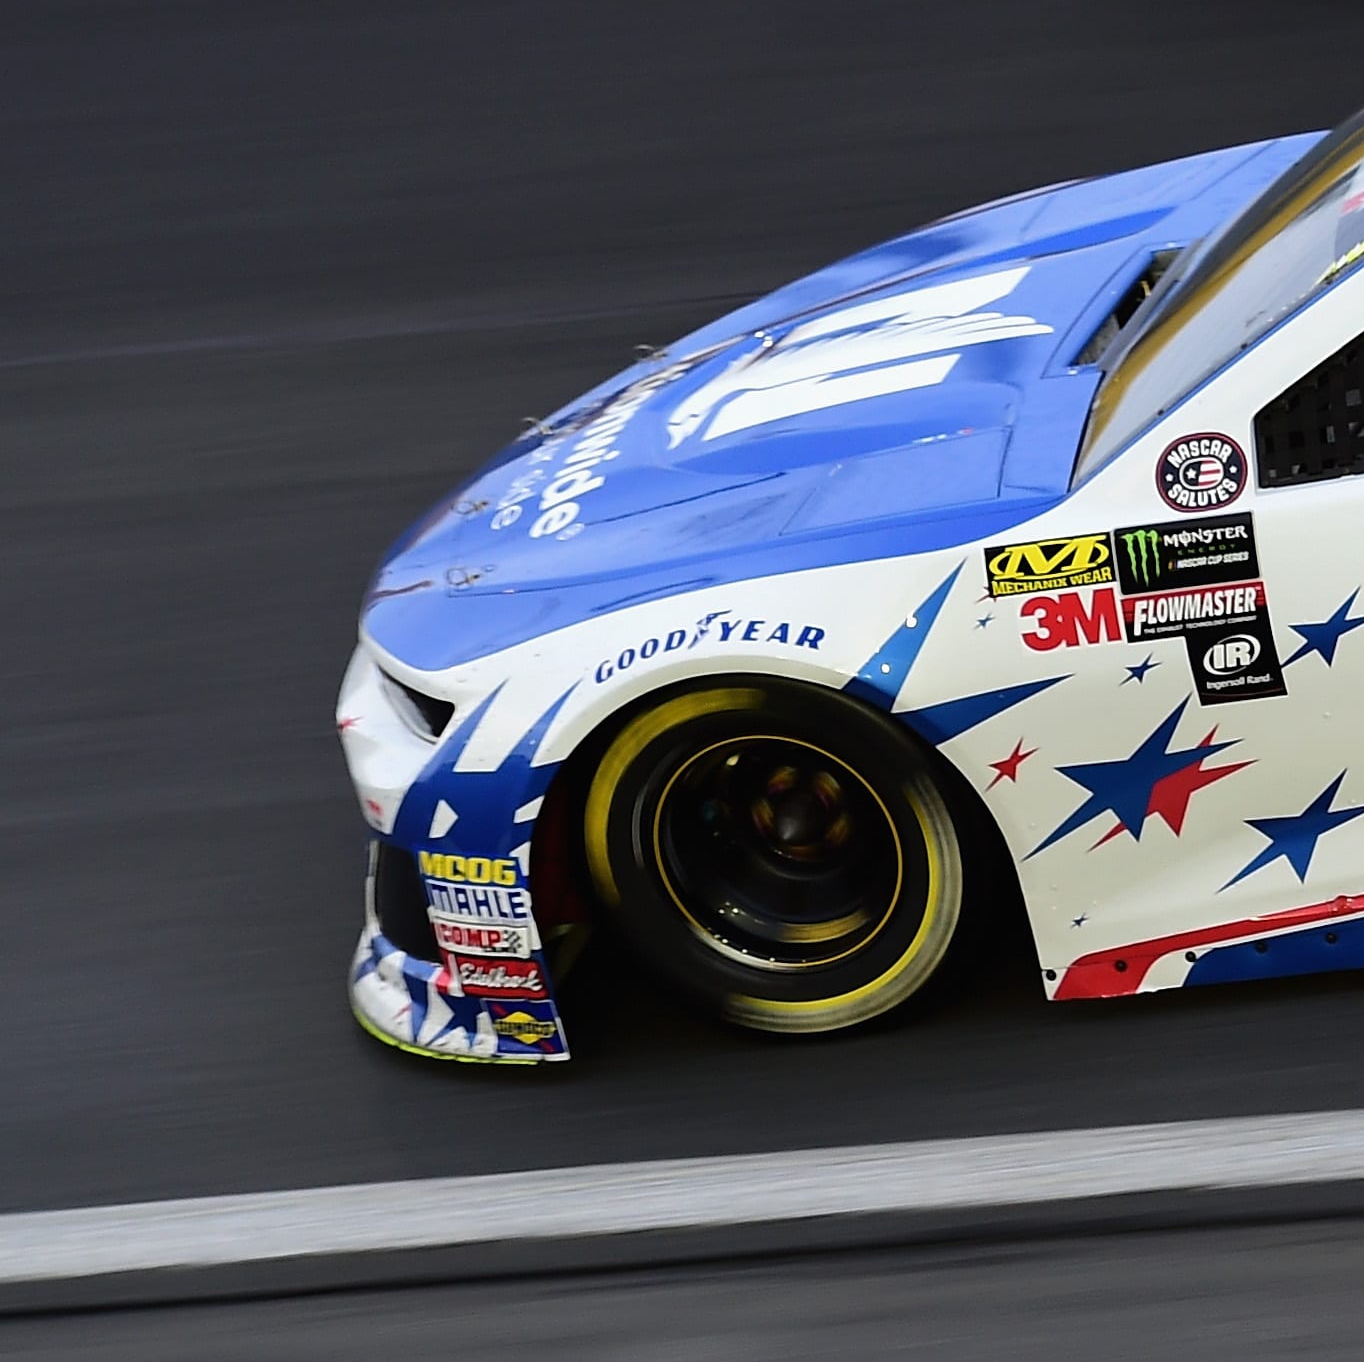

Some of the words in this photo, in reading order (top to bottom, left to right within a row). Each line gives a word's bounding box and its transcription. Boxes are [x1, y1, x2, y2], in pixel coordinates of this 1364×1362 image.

[1167, 439, 1233, 469] NASCAR
[1167, 478, 1239, 508] SALUTES
[1163, 525, 1249, 548] MONSTER
[992, 576, 1068, 595] MECHANIX
[1070, 567, 1113, 584] WEAR
[1020, 587, 1123, 652] 3M
[1133, 587, 1258, 636] FLOWMASTER
[595, 618, 826, 684] GOODYEAR
[1212, 641, 1251, 670] IR
[1206, 676, 1245, 690] Ingersoll
[1246, 673, 1271, 684] Rand
[418, 850, 517, 886] MOOG
[430, 884, 529, 920] MAHLE
[459, 963, 544, 991] Edelbrock
